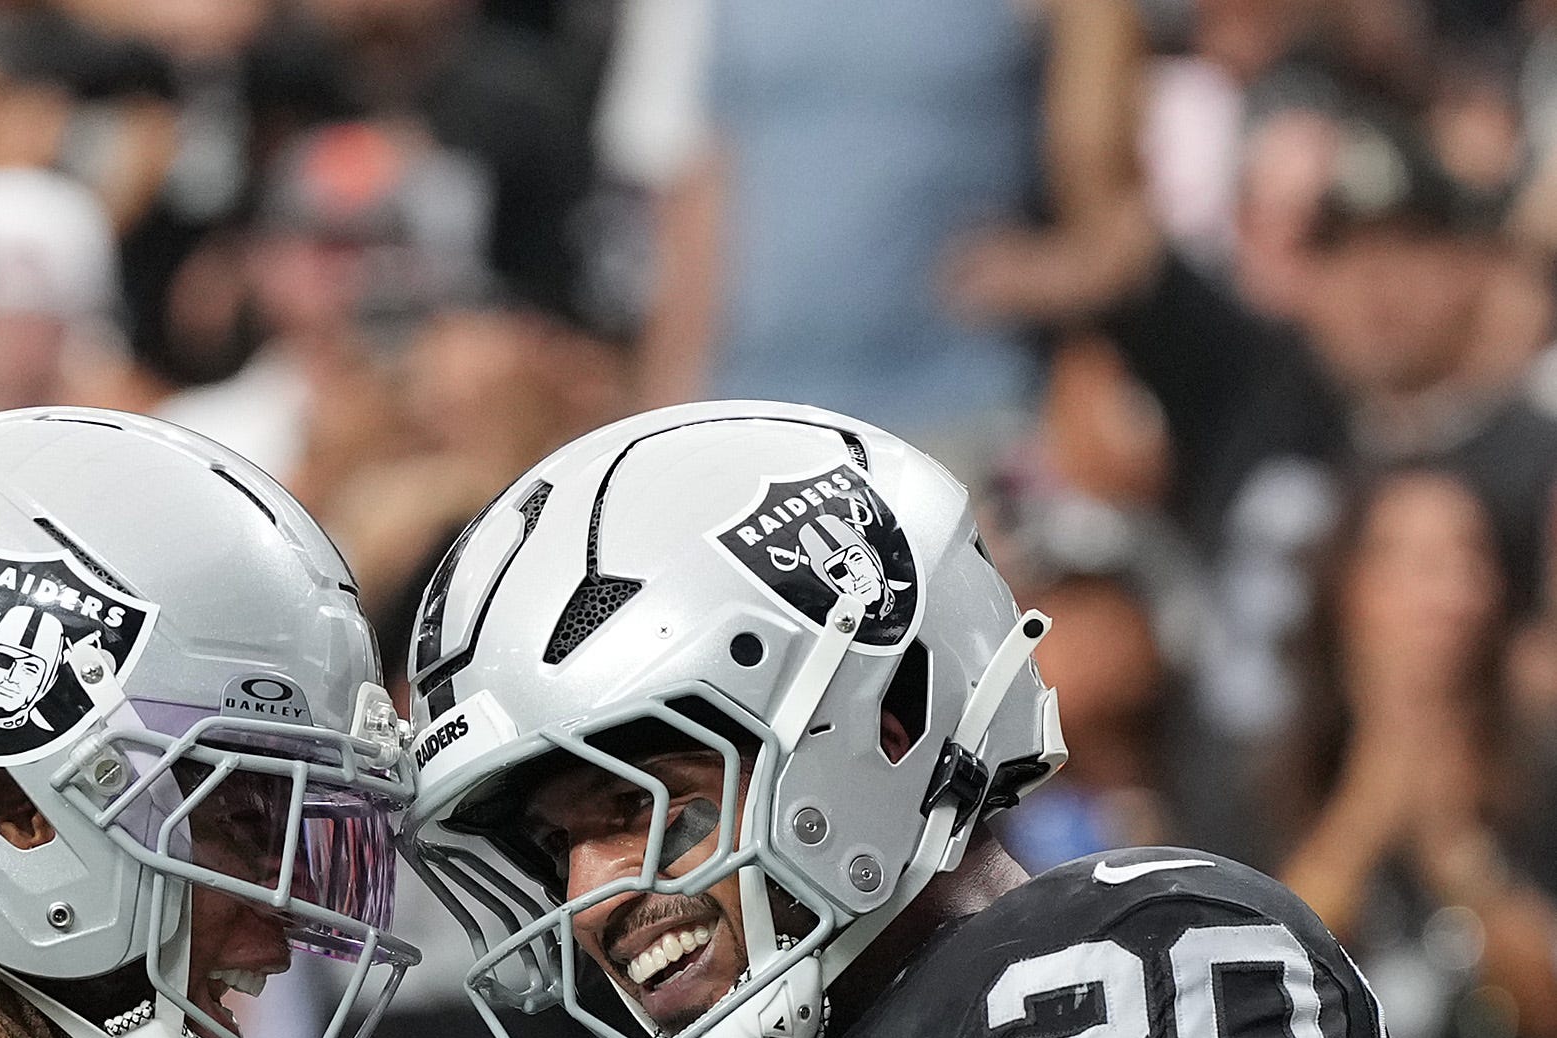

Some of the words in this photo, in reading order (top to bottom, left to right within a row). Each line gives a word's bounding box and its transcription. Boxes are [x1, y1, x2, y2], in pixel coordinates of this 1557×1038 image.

[736, 473, 852, 547] RAIDERS
[225, 697, 303, 718] OAKLEY
[415, 714, 469, 772] RAIDERS
